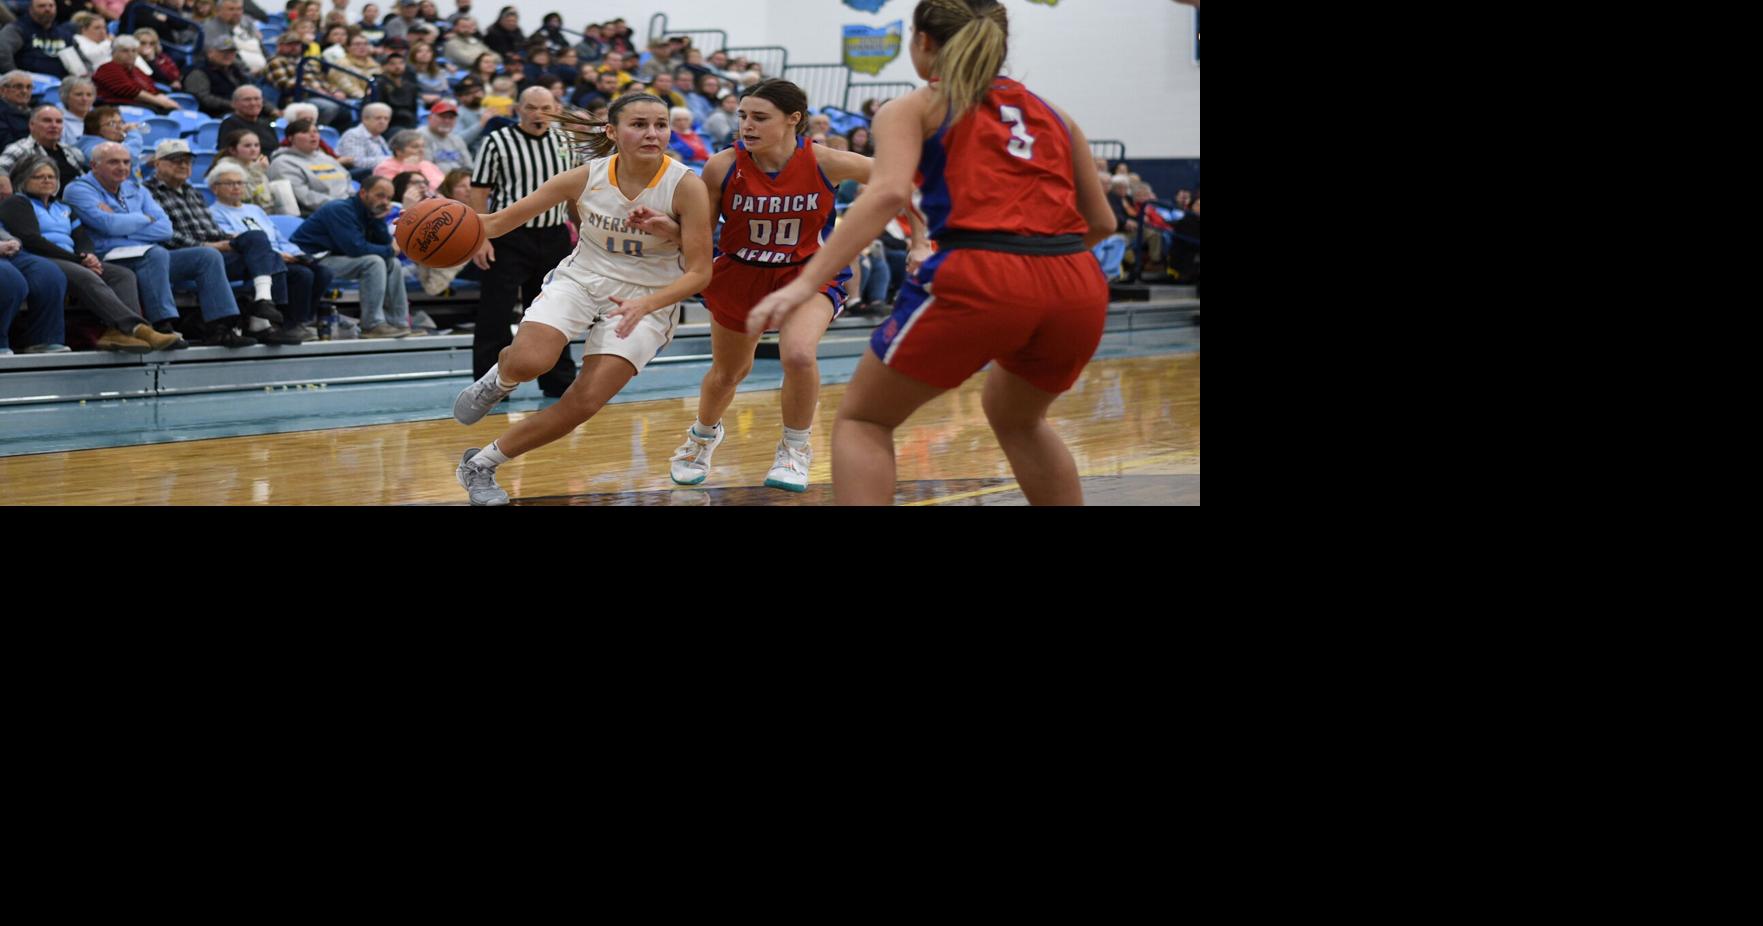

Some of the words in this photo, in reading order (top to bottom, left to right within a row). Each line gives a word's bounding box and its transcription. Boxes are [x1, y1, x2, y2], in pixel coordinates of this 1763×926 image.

[1000, 104, 1034, 160] 3
[732, 193, 819, 213] PATRICK
[749, 218, 800, 245] 00
